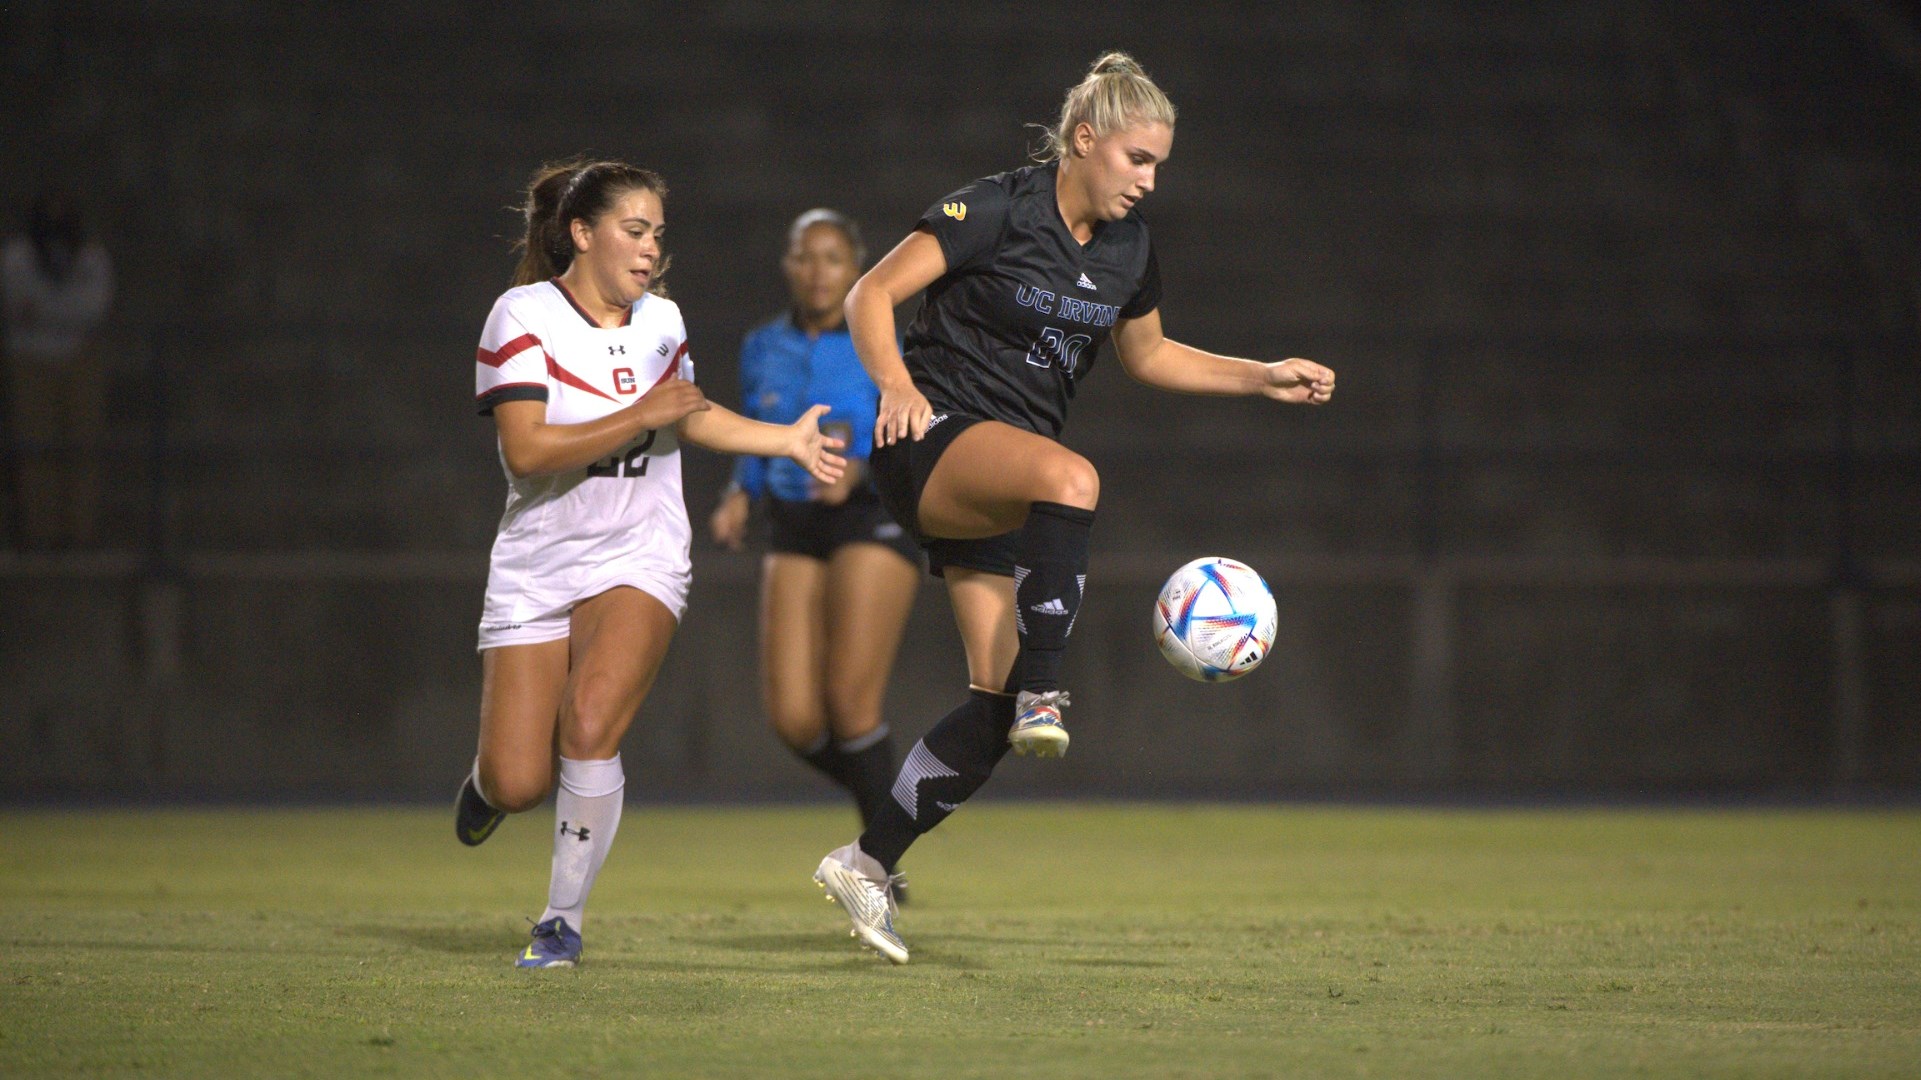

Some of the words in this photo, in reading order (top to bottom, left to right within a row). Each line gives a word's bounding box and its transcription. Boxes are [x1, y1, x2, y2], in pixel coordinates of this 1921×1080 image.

[1016, 283, 1056, 314] UC
[1058, 296, 1121, 326] IRVIN
[612, 367, 637, 395] C
[1030, 605, 1069, 615] adidas
